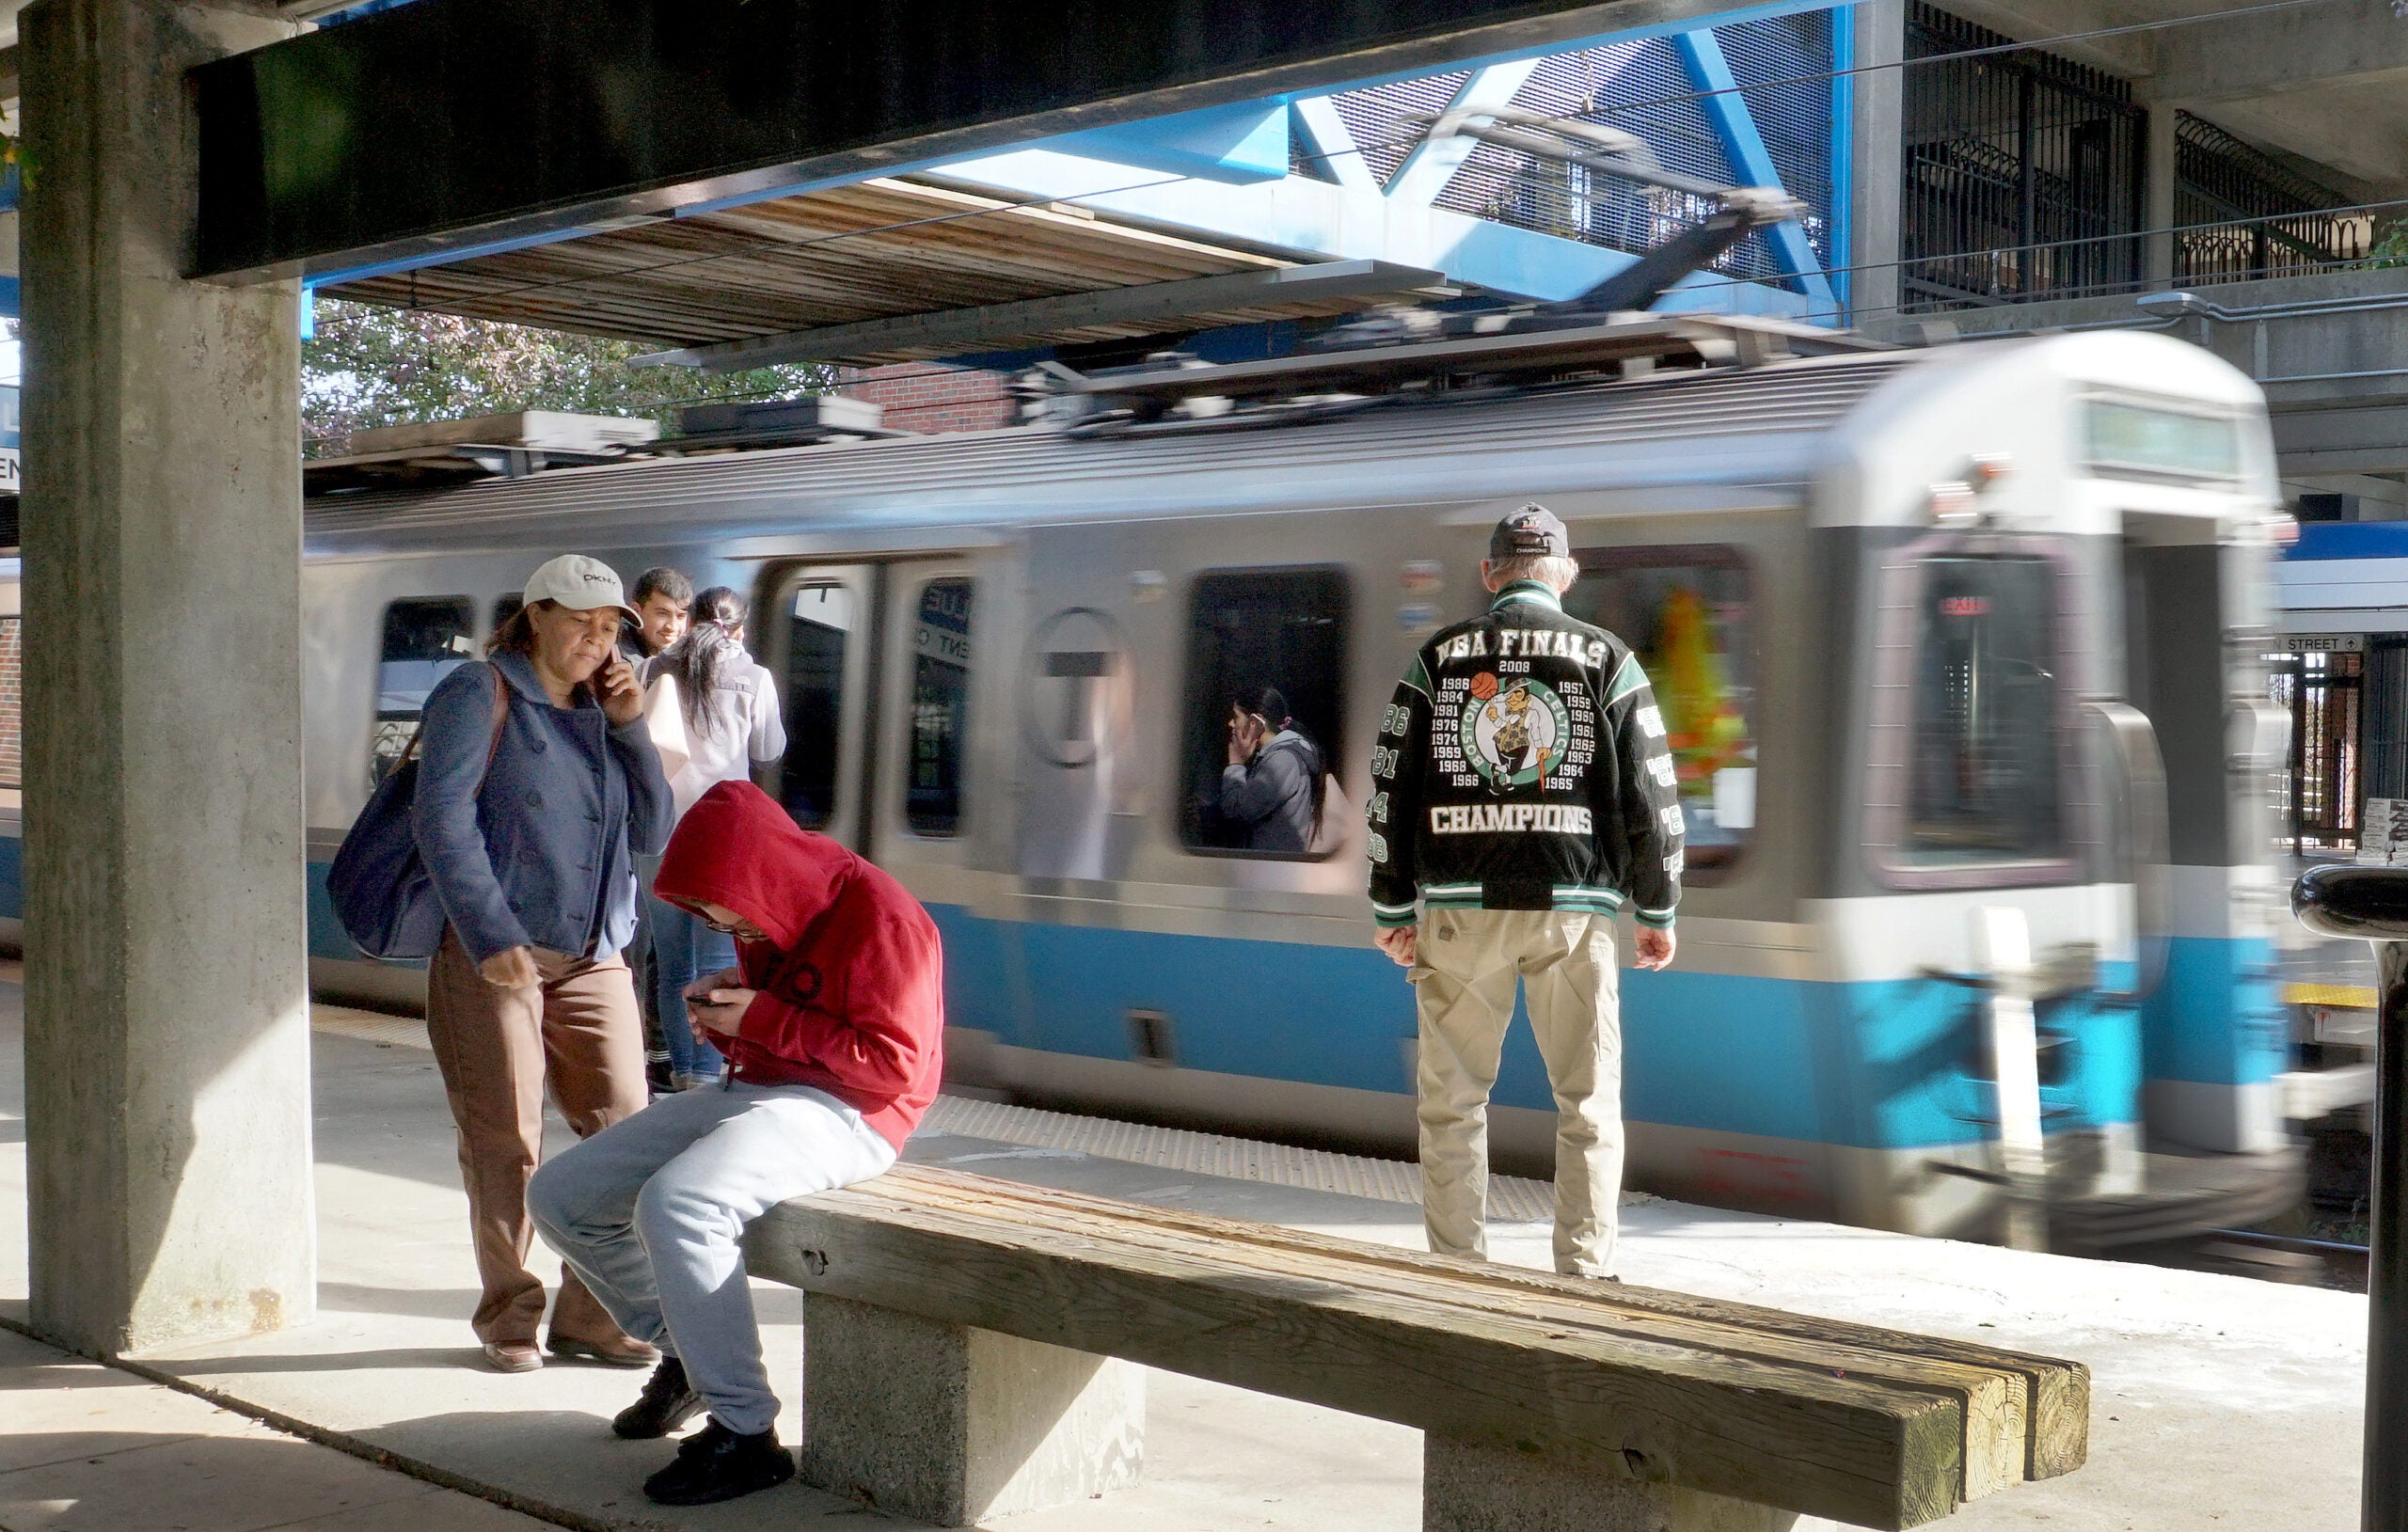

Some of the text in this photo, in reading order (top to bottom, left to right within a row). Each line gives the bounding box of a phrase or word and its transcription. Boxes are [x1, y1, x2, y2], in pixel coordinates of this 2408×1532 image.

[1435, 629, 1607, 670] NBA FINALS
[2288, 639, 2339, 650] STREET
[1498, 660, 1530, 673] 2008
[1442, 677, 1470, 690] 1986
[1558, 681, 1584, 695] 1957
[1436, 690, 1464, 703] 1984
[1566, 695, 1591, 710] 1959
[1434, 704, 1459, 717] 1981
[1571, 709, 1594, 724] 1960
[1431, 719, 1459, 732] 1976
[1544, 688, 1569, 758] CELTICS
[1462, 699, 1485, 768] BOSTON
[1572, 723, 1594, 738] 1961
[1431, 733, 1459, 746] 1974
[1570, 737, 1595, 753] 1962
[1433, 746, 1462, 759] 1969
[1567, 750, 1592, 765] 1963
[1438, 760, 1466, 773] 1968
[1558, 764, 1584, 778] 1964
[1451, 774, 1480, 786] 1966
[1545, 777, 1574, 791] 1965
[1430, 803, 1593, 836] CHAMPIONS
